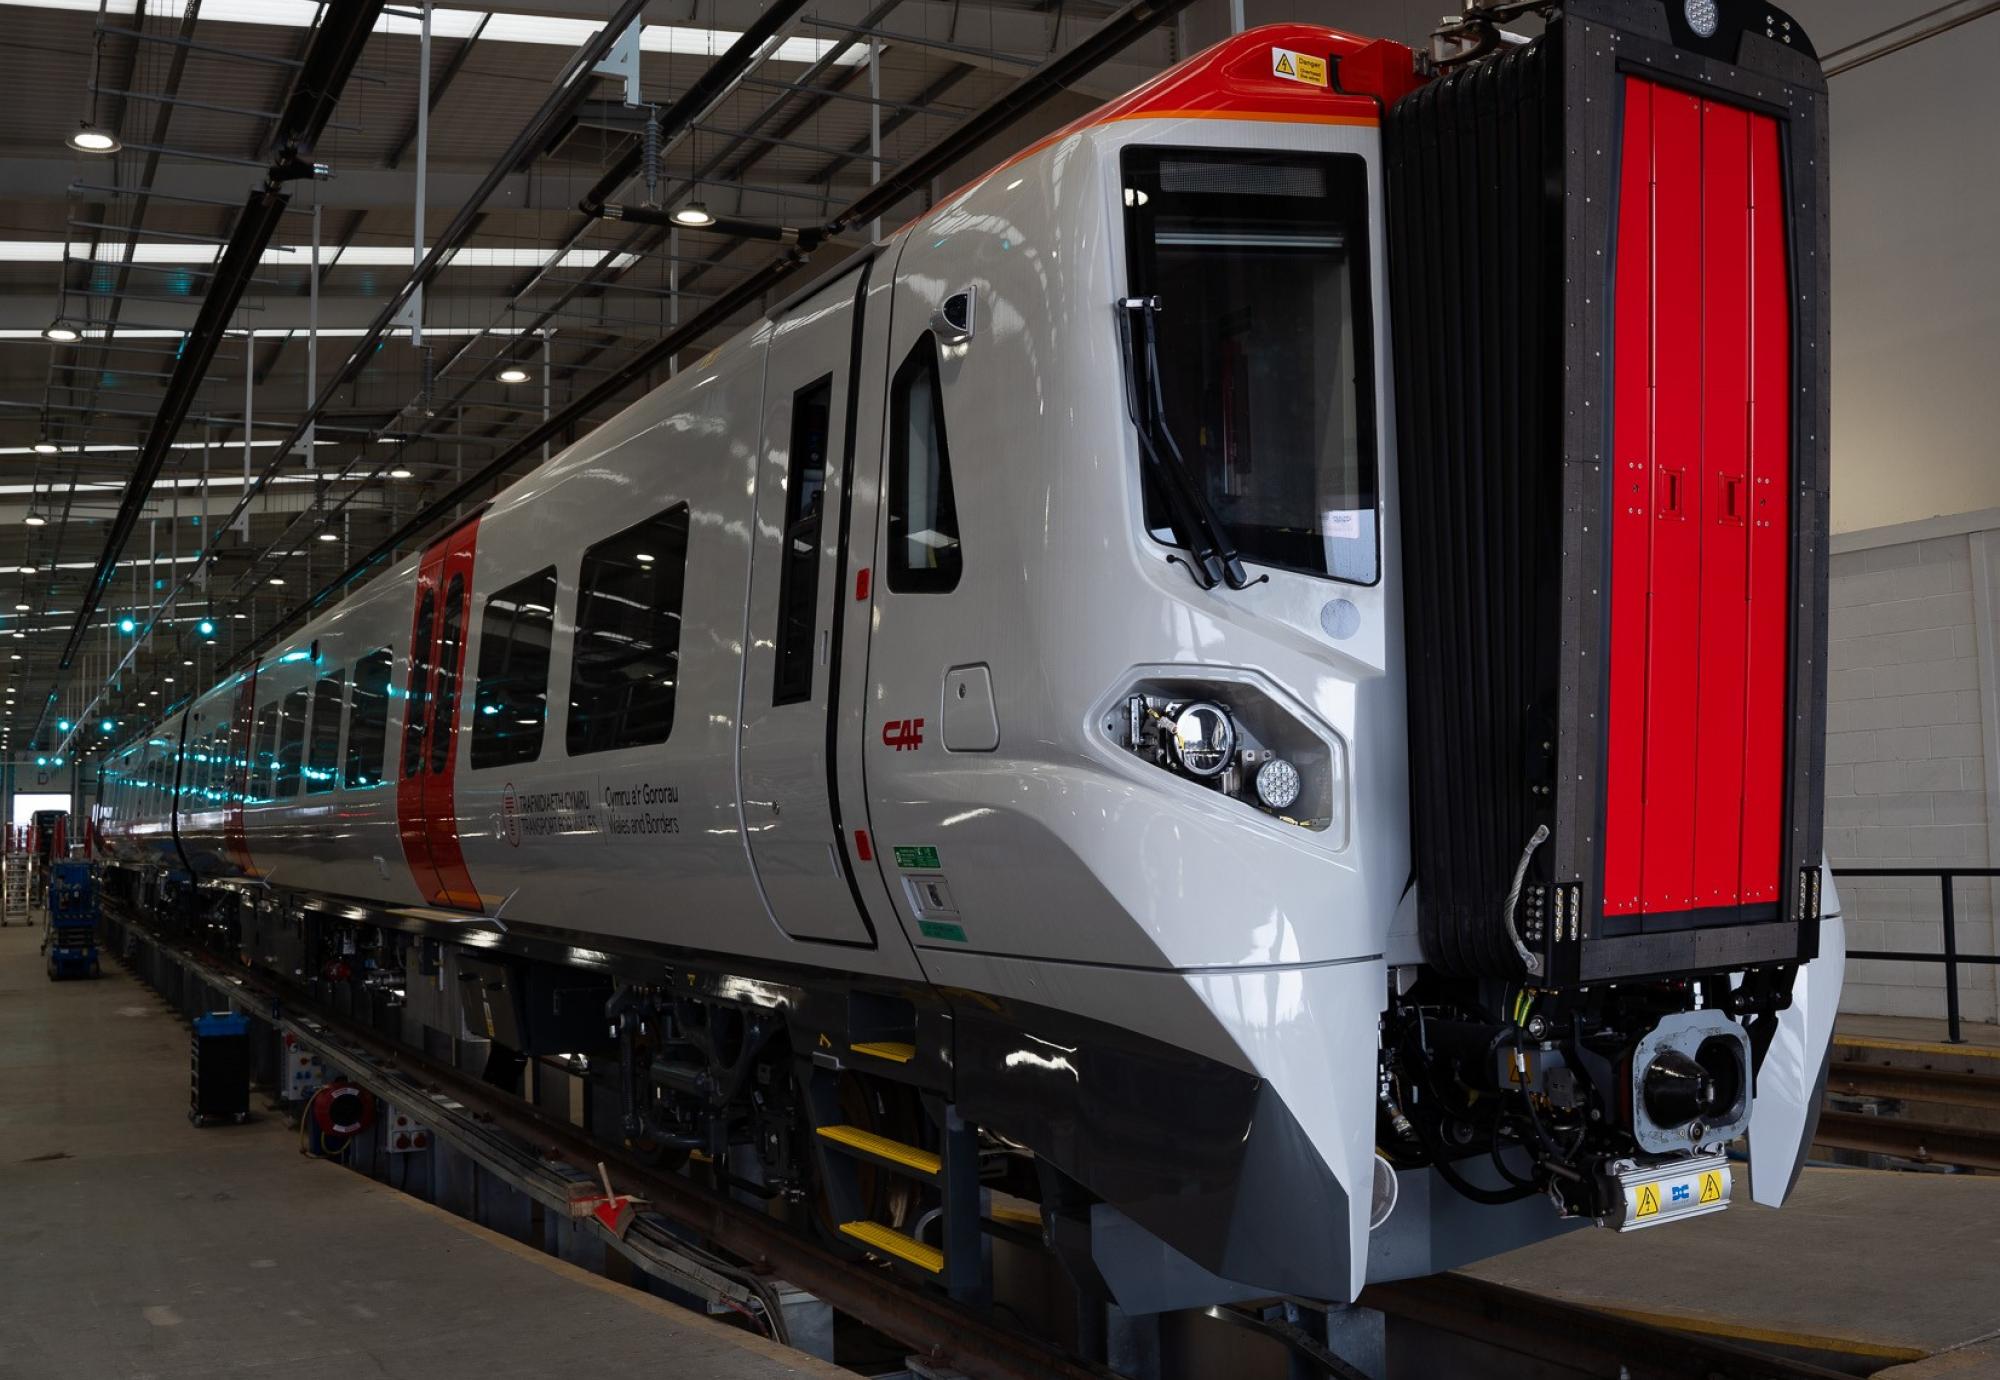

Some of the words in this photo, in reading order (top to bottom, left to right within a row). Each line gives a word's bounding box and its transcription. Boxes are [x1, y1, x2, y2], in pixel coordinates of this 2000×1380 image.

[1299, 57, 1321, 68] Danger
[883, 718, 925, 751] CAF
[605, 786, 631, 812] Cymru
[642, 783, 679, 805] Gororau
[608, 814, 631, 834] Wales
[631, 813, 645, 834] and
[645, 812, 680, 834] Borders
